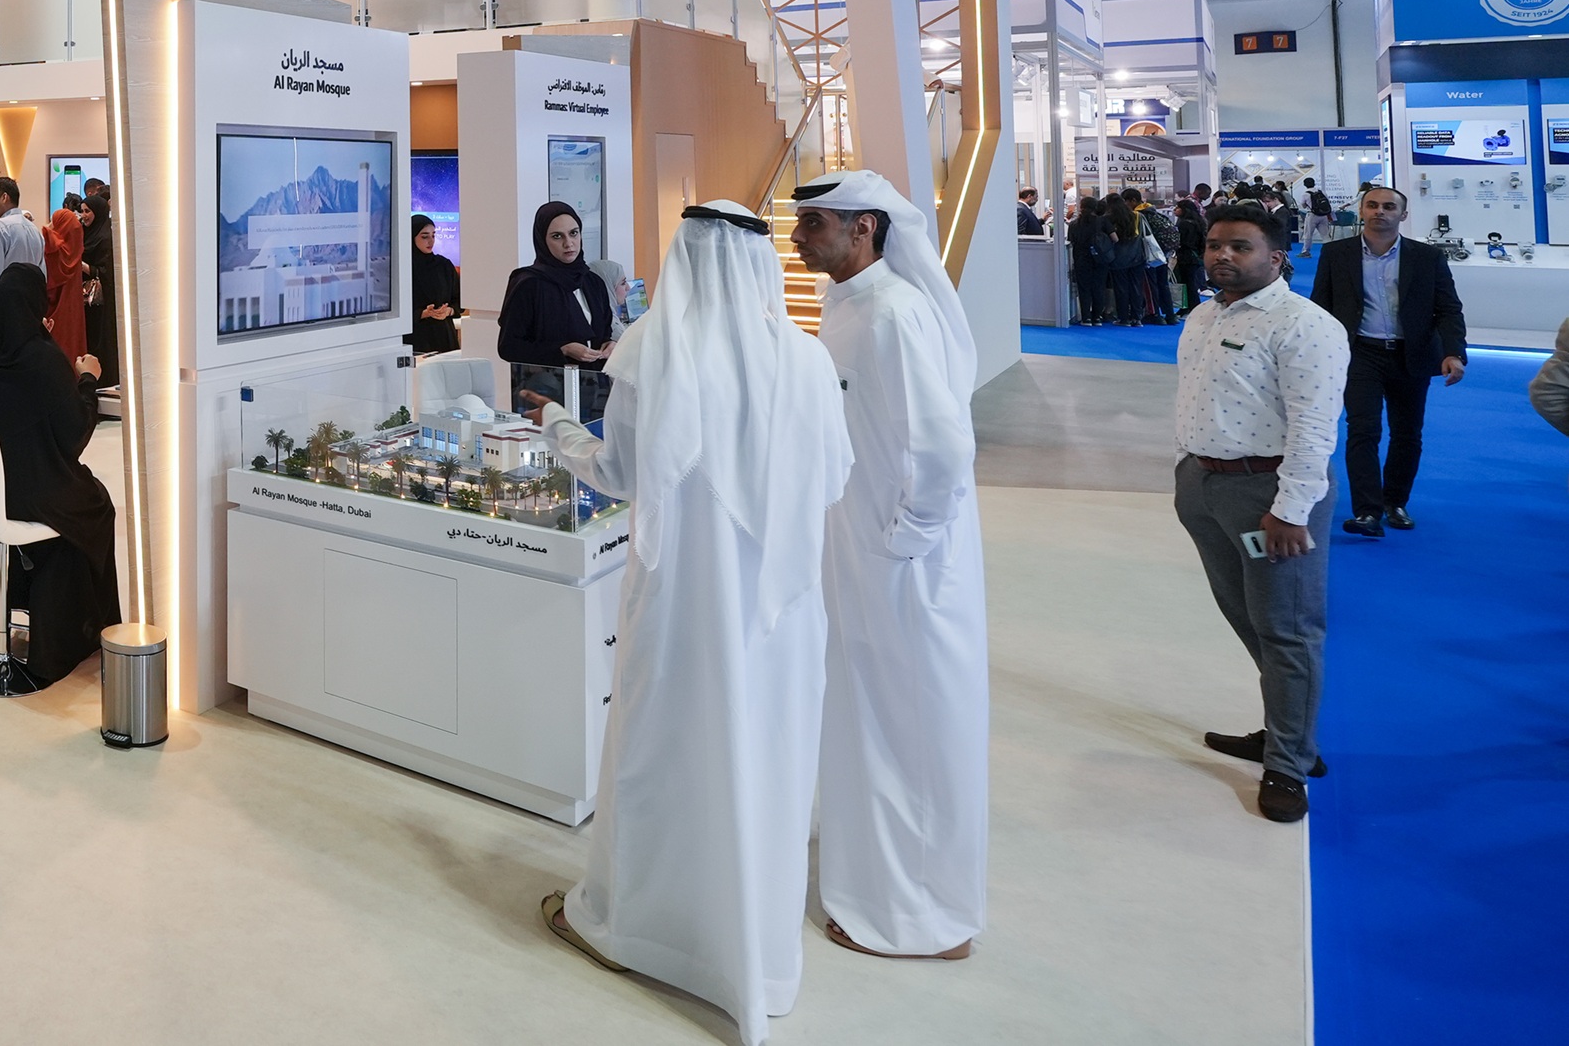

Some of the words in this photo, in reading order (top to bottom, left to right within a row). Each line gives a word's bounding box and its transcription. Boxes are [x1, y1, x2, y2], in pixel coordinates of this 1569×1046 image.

[1533, 9, 1554, 17] 1924
[1245, 37, 1253, 49] 7
[1276, 35, 1285, 47] 7
[281, 48, 310, 72] الريان
[312, 57, 344, 75] مسجد
[273, 75, 284, 89] Al
[287, 76, 314, 95] Rayan
[316, 79, 351, 98] Mosque
[1446, 91, 1483, 99] Water
[568, 102, 585, 113] Virtual
[586, 103, 609, 117] Employee
[1083, 153, 1114, 163] الياه
[1118, 153, 1156, 163] معالجة
[1082, 165, 1118, 174] صيقة
[1122, 164, 1156, 174] بتقنية
[252, 487, 259, 495] Al
[261, 488, 285, 500] Rayan
[287, 493, 317, 507] Mosque
[347, 505, 372, 518] Dubai
[446, 528, 461, 539] دبي
[617, 534, 629, 546] Mosq
[515, 541, 548, 554] مسجد
